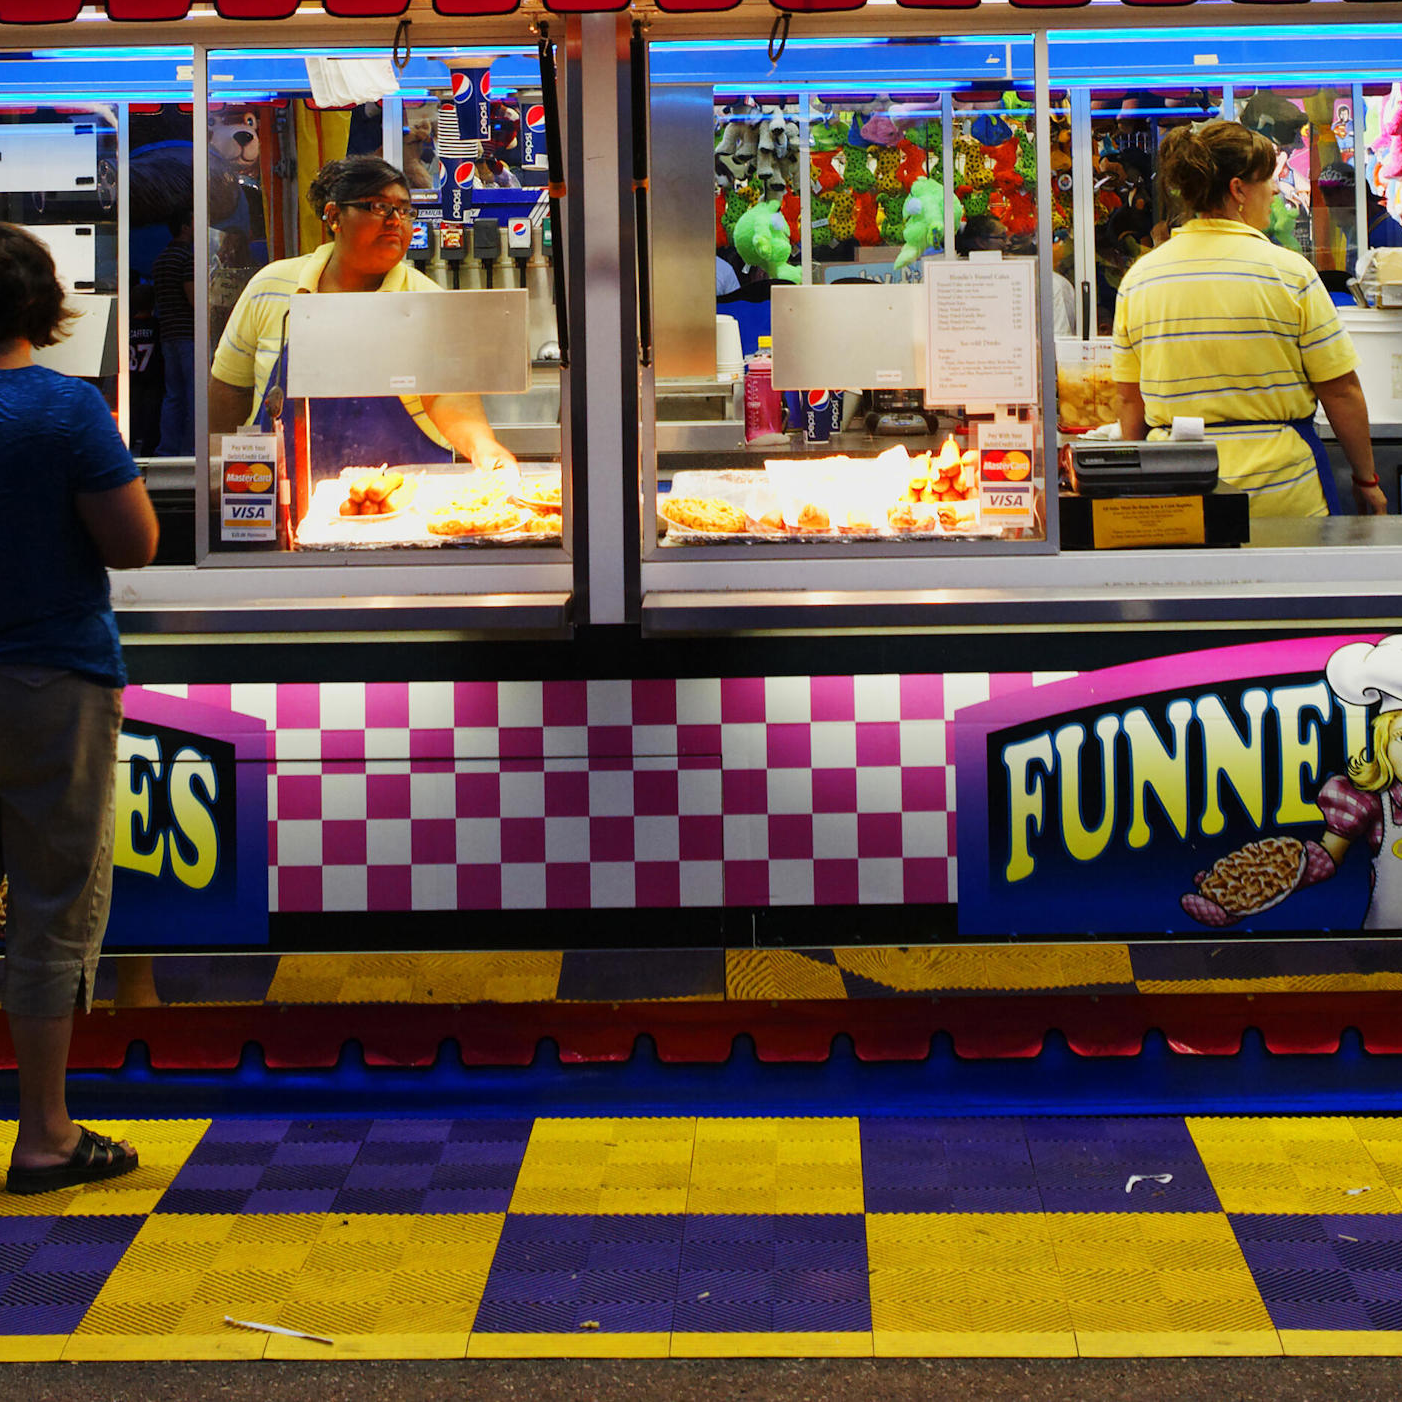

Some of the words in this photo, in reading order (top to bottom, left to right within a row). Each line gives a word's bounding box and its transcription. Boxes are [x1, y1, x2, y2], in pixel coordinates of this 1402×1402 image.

[479, 101, 488, 135] pepsi
[524, 132, 533, 163] pepsi
[452, 189, 462, 219] pepsi
[806, 411, 816, 439] pepsi
[831, 400, 840, 430] pepsi
[226, 473, 272, 482] MasterCard
[983, 462, 1029, 471] MasterCard
[232, 506, 265, 518] VISA
[990, 495, 1023, 507] VISA
